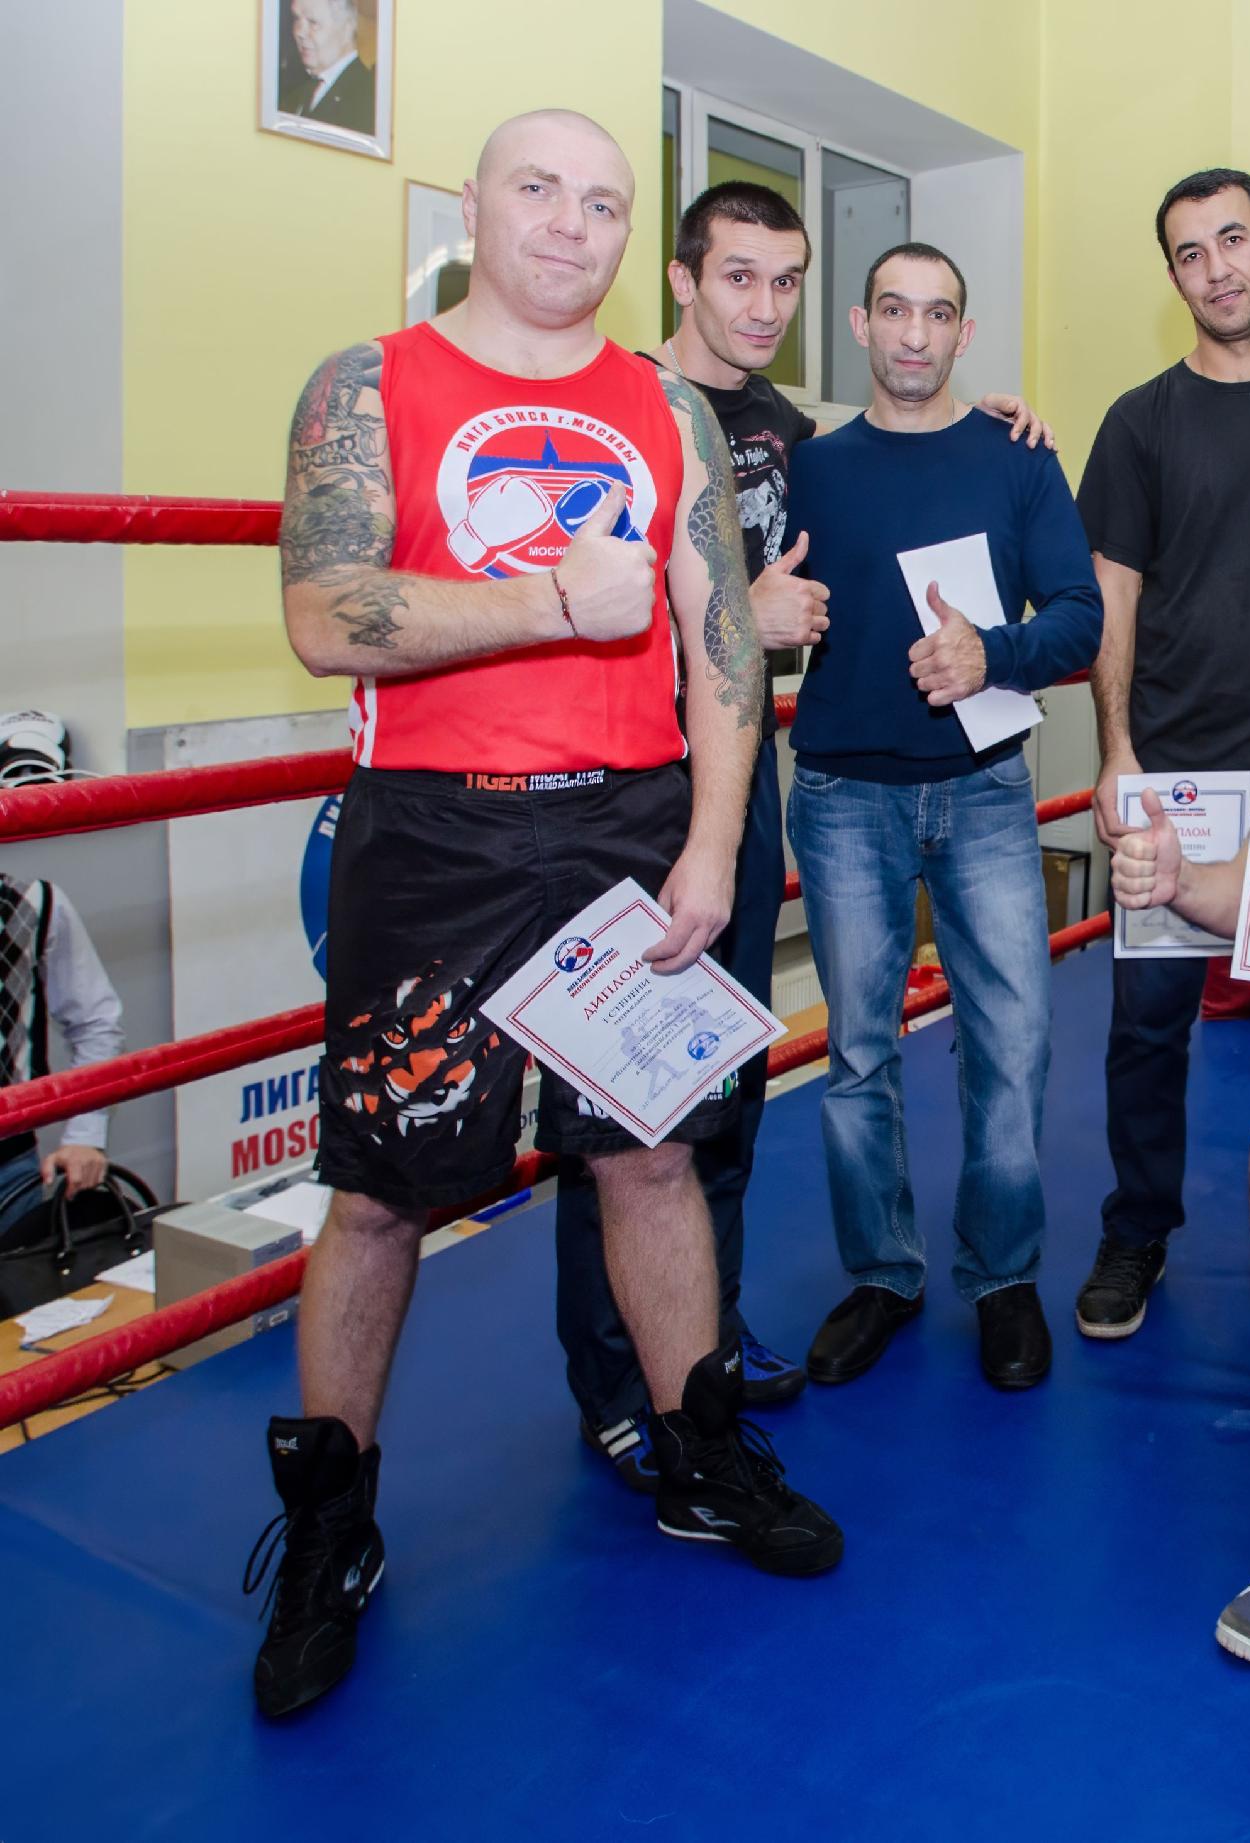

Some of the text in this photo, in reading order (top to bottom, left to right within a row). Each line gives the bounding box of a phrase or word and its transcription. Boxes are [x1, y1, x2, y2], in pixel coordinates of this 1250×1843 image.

[456, 421, 491, 453] ЛИГА
[496, 411, 549, 426] БОКСА
[528, 546, 567, 557] МОСК
[1178, 826, 1211, 837] ПЛОМ
[582, 959, 645, 1020] ДИПЛОМ
[608, 979, 651, 1018] СТЕПЕНИ
[232, 1113, 320, 1178] MOSC
